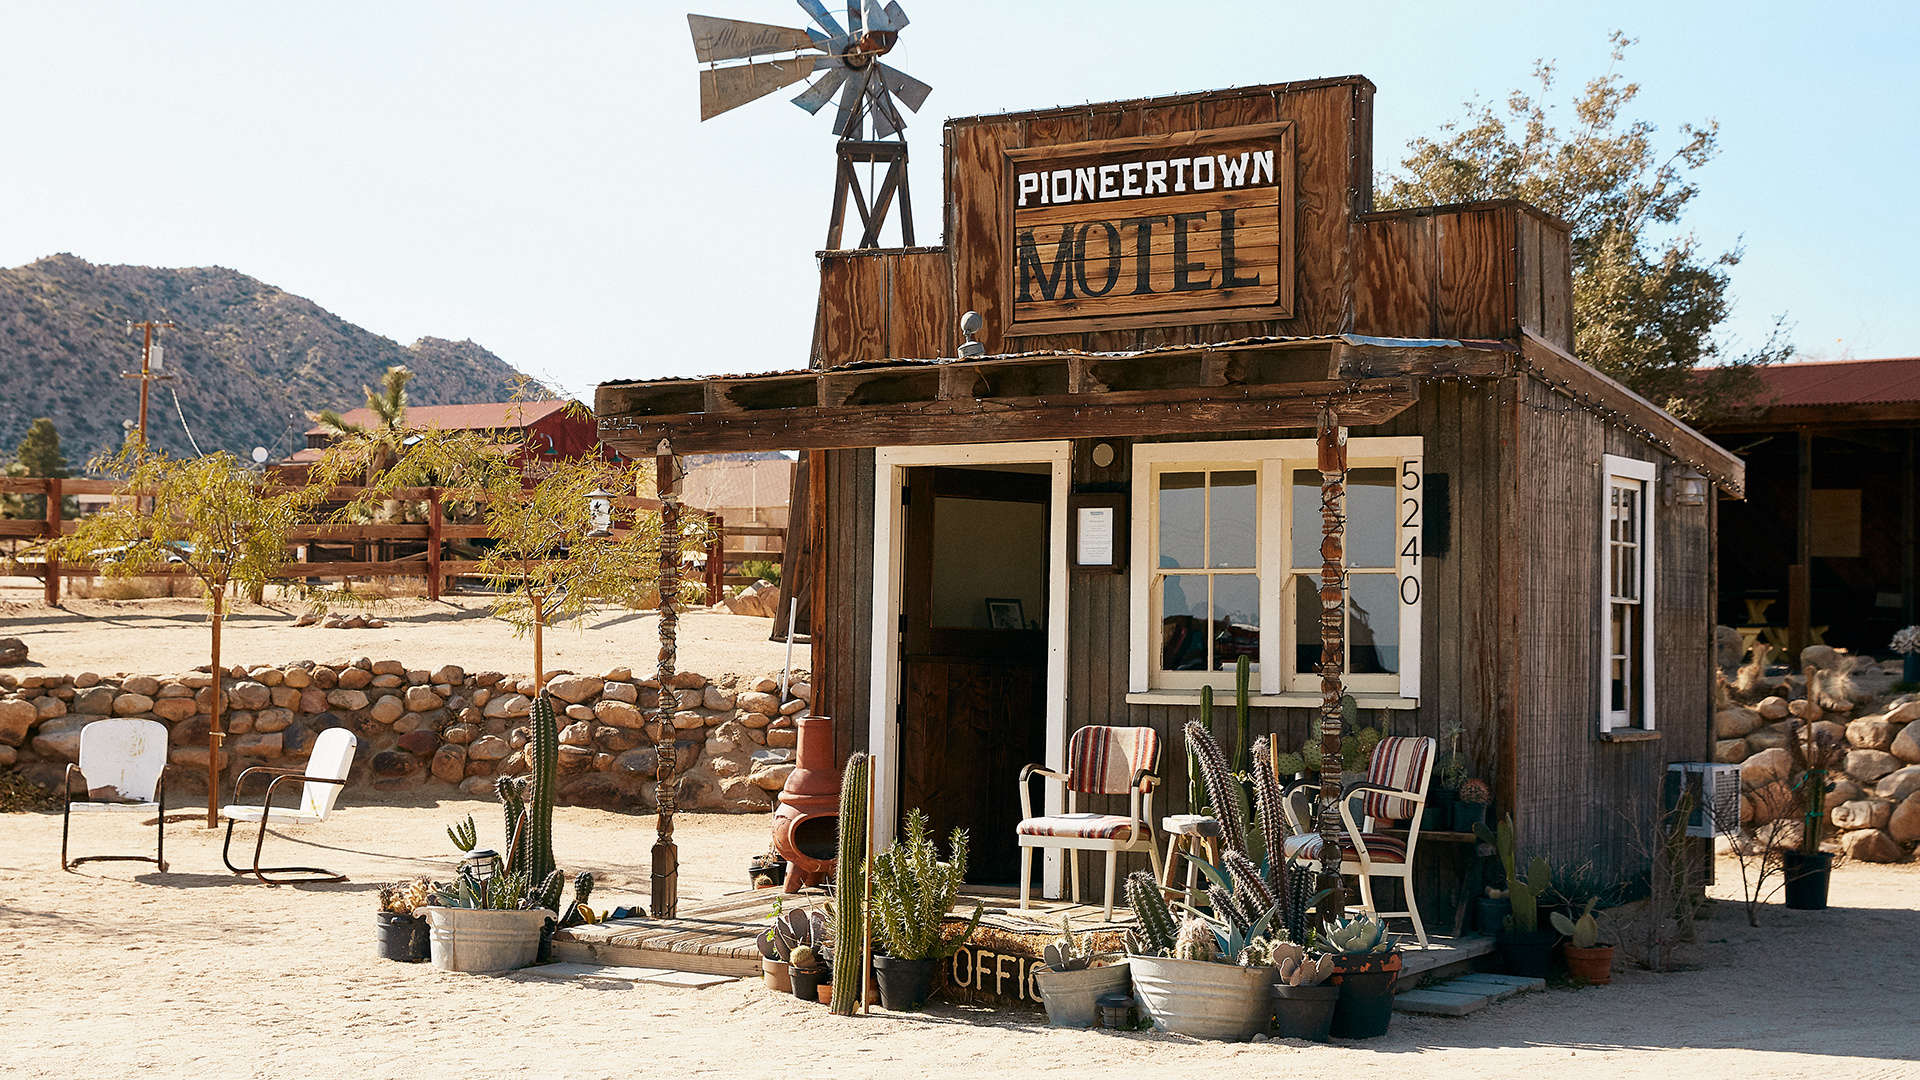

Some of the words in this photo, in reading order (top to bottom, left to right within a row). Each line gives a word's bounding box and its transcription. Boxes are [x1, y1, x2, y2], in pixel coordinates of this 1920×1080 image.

[1018, 150, 1275, 206] PIONEERTOWN
[1015, 208, 1260, 302] MOTEL
[1400, 460, 1420, 605] 5240
[953, 945, 1050, 1003] OFFIC
